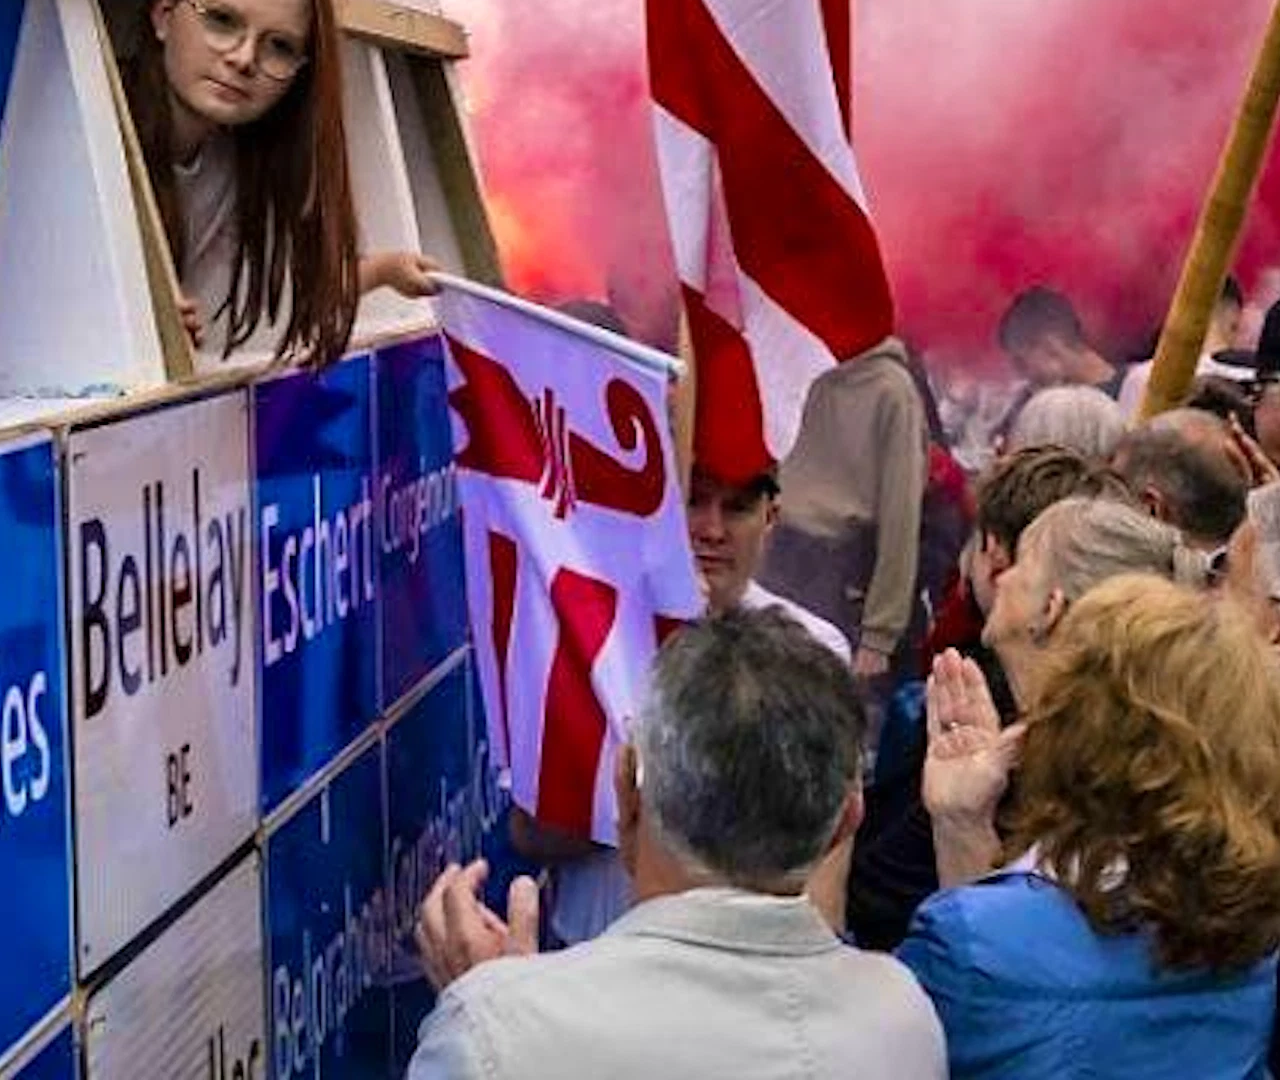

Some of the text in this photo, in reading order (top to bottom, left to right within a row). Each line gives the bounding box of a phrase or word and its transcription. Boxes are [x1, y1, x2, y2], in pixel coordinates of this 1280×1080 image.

[80, 467, 246, 720] Bellelay
[262, 472, 374, 667] Eschert
[167, 743, 193, 829] BE
